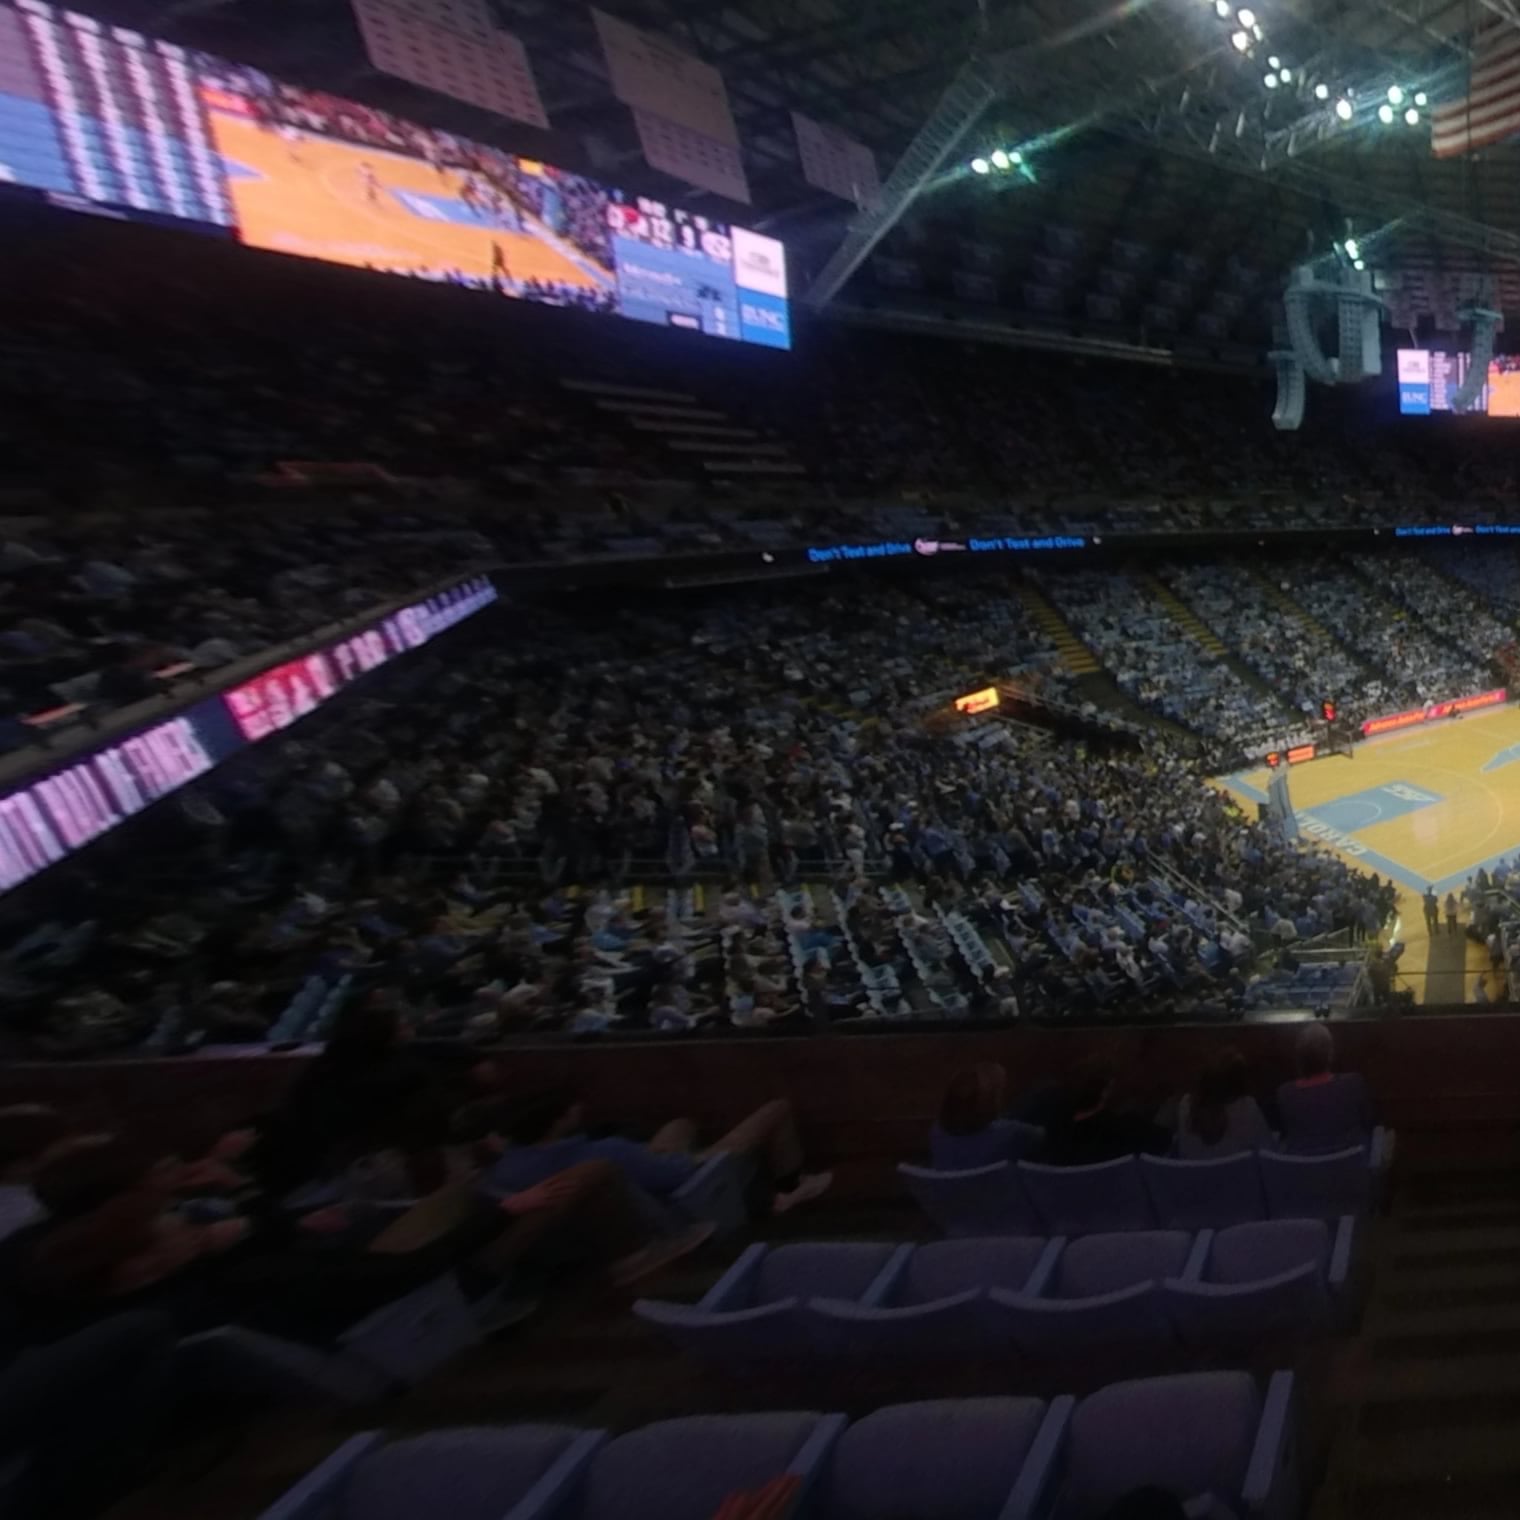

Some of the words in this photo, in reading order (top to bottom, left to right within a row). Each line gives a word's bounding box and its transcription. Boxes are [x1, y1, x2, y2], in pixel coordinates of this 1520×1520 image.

[808, 547, 841, 561] Don't
[841, 545, 865, 558] Text
[866, 544, 885, 556] and
[886, 542, 911, 554] Drive
[969, 537, 1004, 551] Don't
[1005, 537, 1029, 549] Text
[1032, 536, 1053, 549] and
[1054, 535, 1085, 548] Drive
